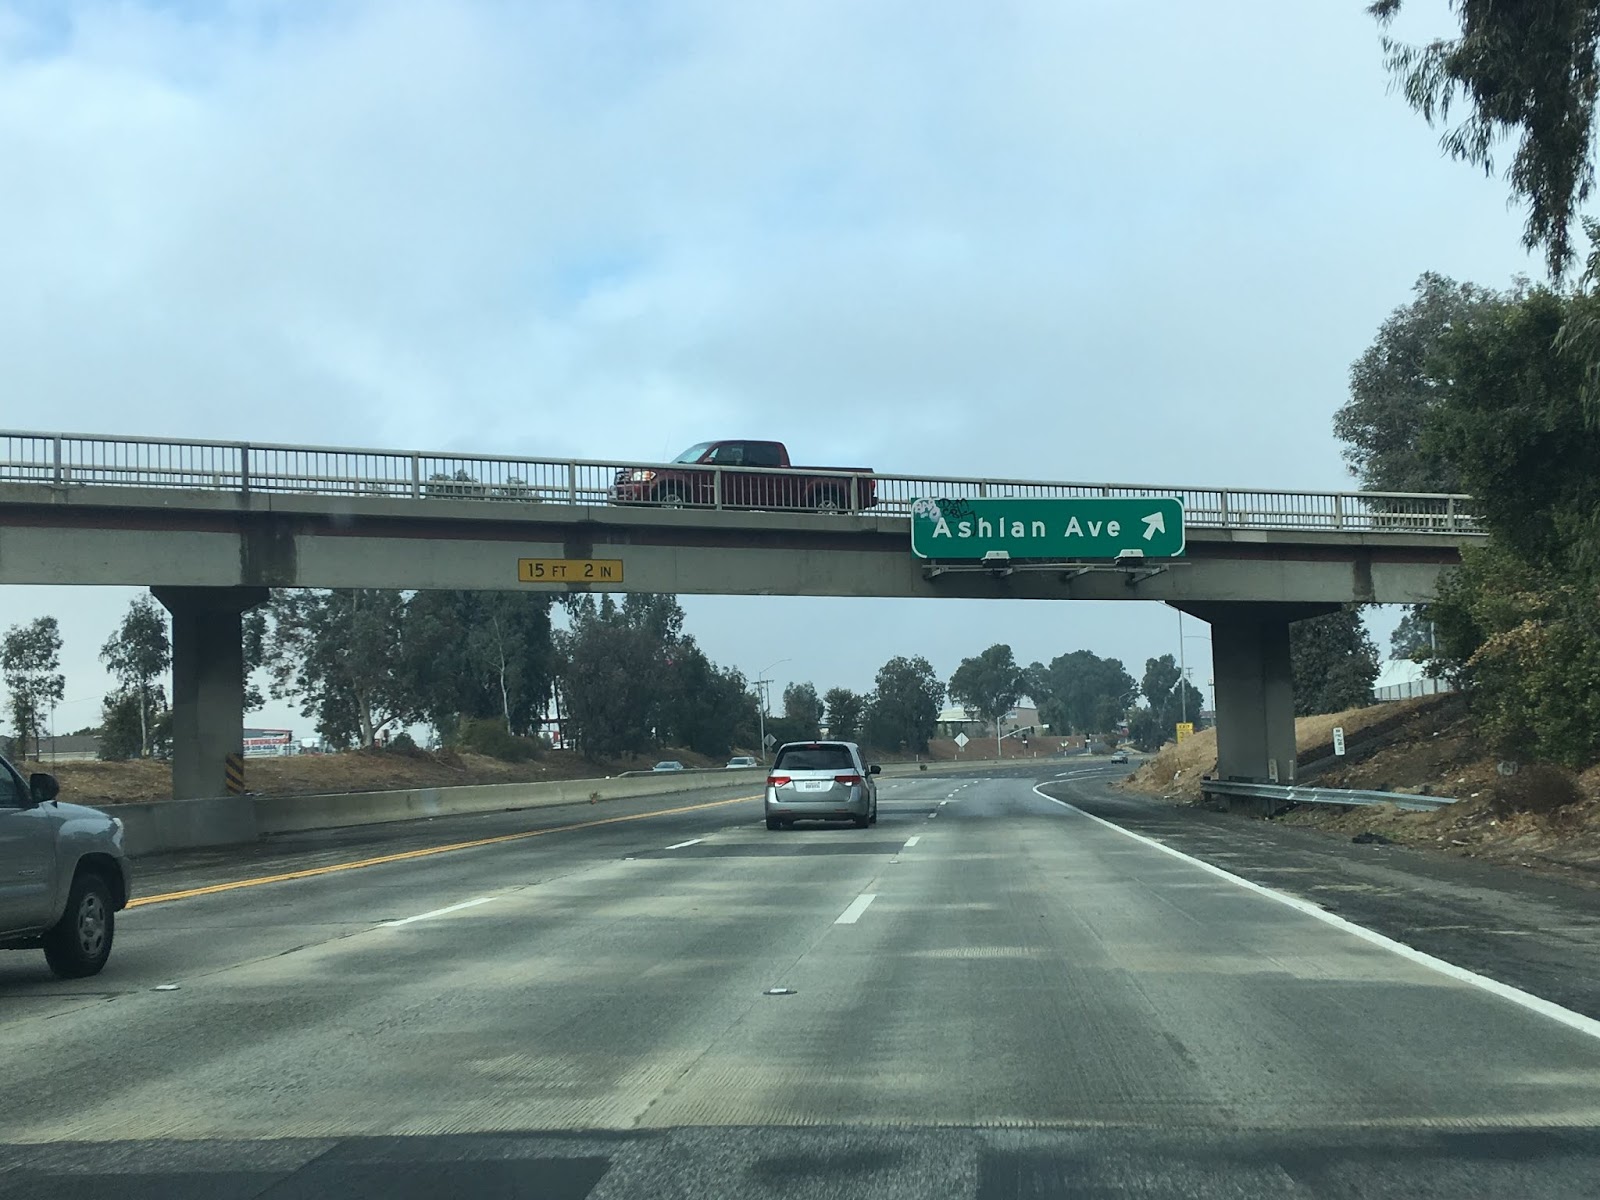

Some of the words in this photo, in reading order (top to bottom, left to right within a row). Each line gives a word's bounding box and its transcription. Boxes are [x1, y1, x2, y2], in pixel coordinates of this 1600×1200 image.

[933, 516, 1046, 538] Ashlan
[1064, 516, 1121, 537] Ave
[528, 563, 545, 577] 15
[552, 565, 567, 577] FT
[584, 563, 594, 577] 2
[600, 566, 611, 577] IN
